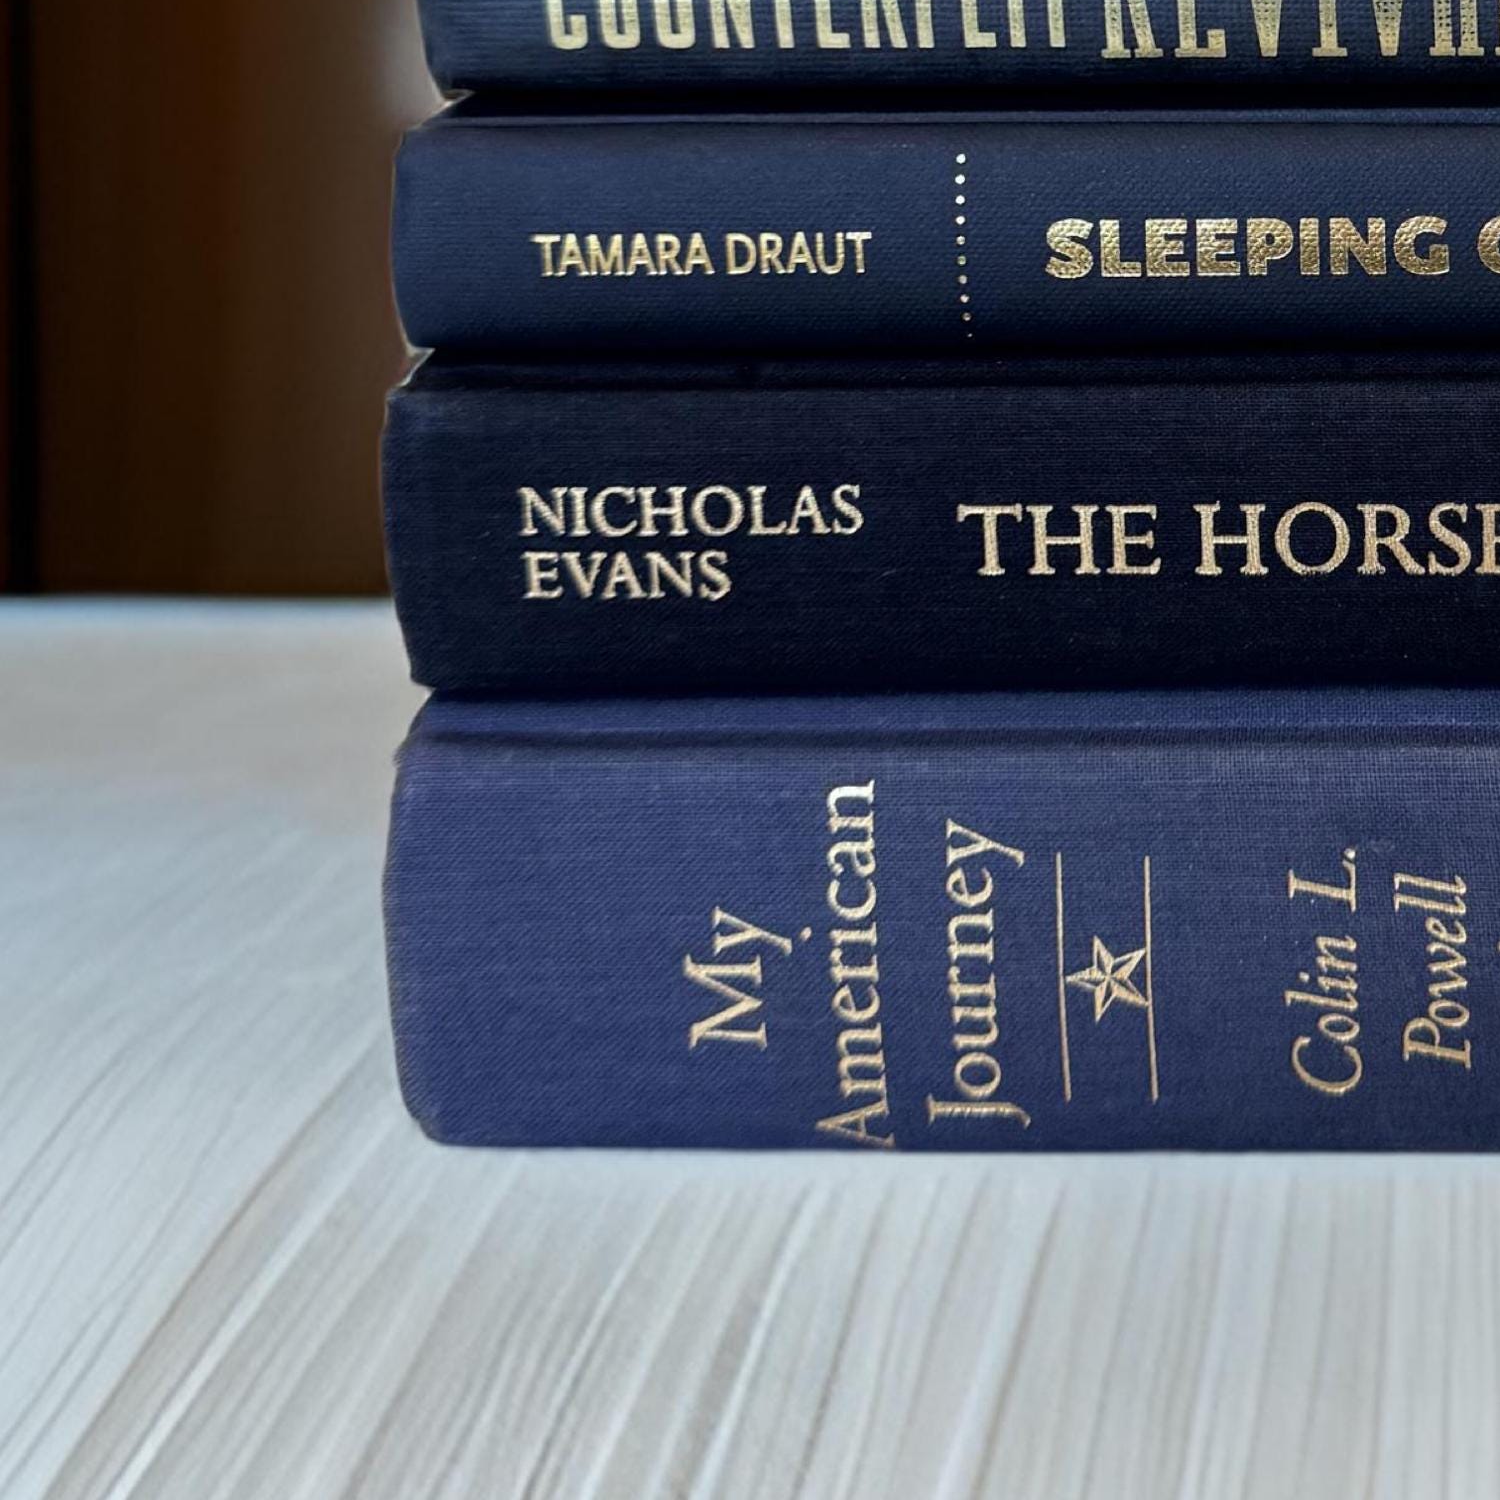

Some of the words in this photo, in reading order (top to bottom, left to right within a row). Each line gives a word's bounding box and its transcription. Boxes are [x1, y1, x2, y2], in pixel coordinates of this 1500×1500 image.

[533, 232, 716, 277] TAMARA
[724, 231, 872, 276] DRAUT
[1044, 216, 1450, 279] SLEEPING
[518, 483, 865, 538] NICHOLAS
[957, 502, 1162, 577] THE
[521, 550, 732, 600] EVANS
[1287, 847, 1357, 912] L.
[683, 905, 793, 1052] My
[800, 778, 895, 1149] American
[928, 818, 1032, 1129] Journey
[1393, 871, 1472, 1069] Powell
[1284, 934, 1363, 1096] Colin
